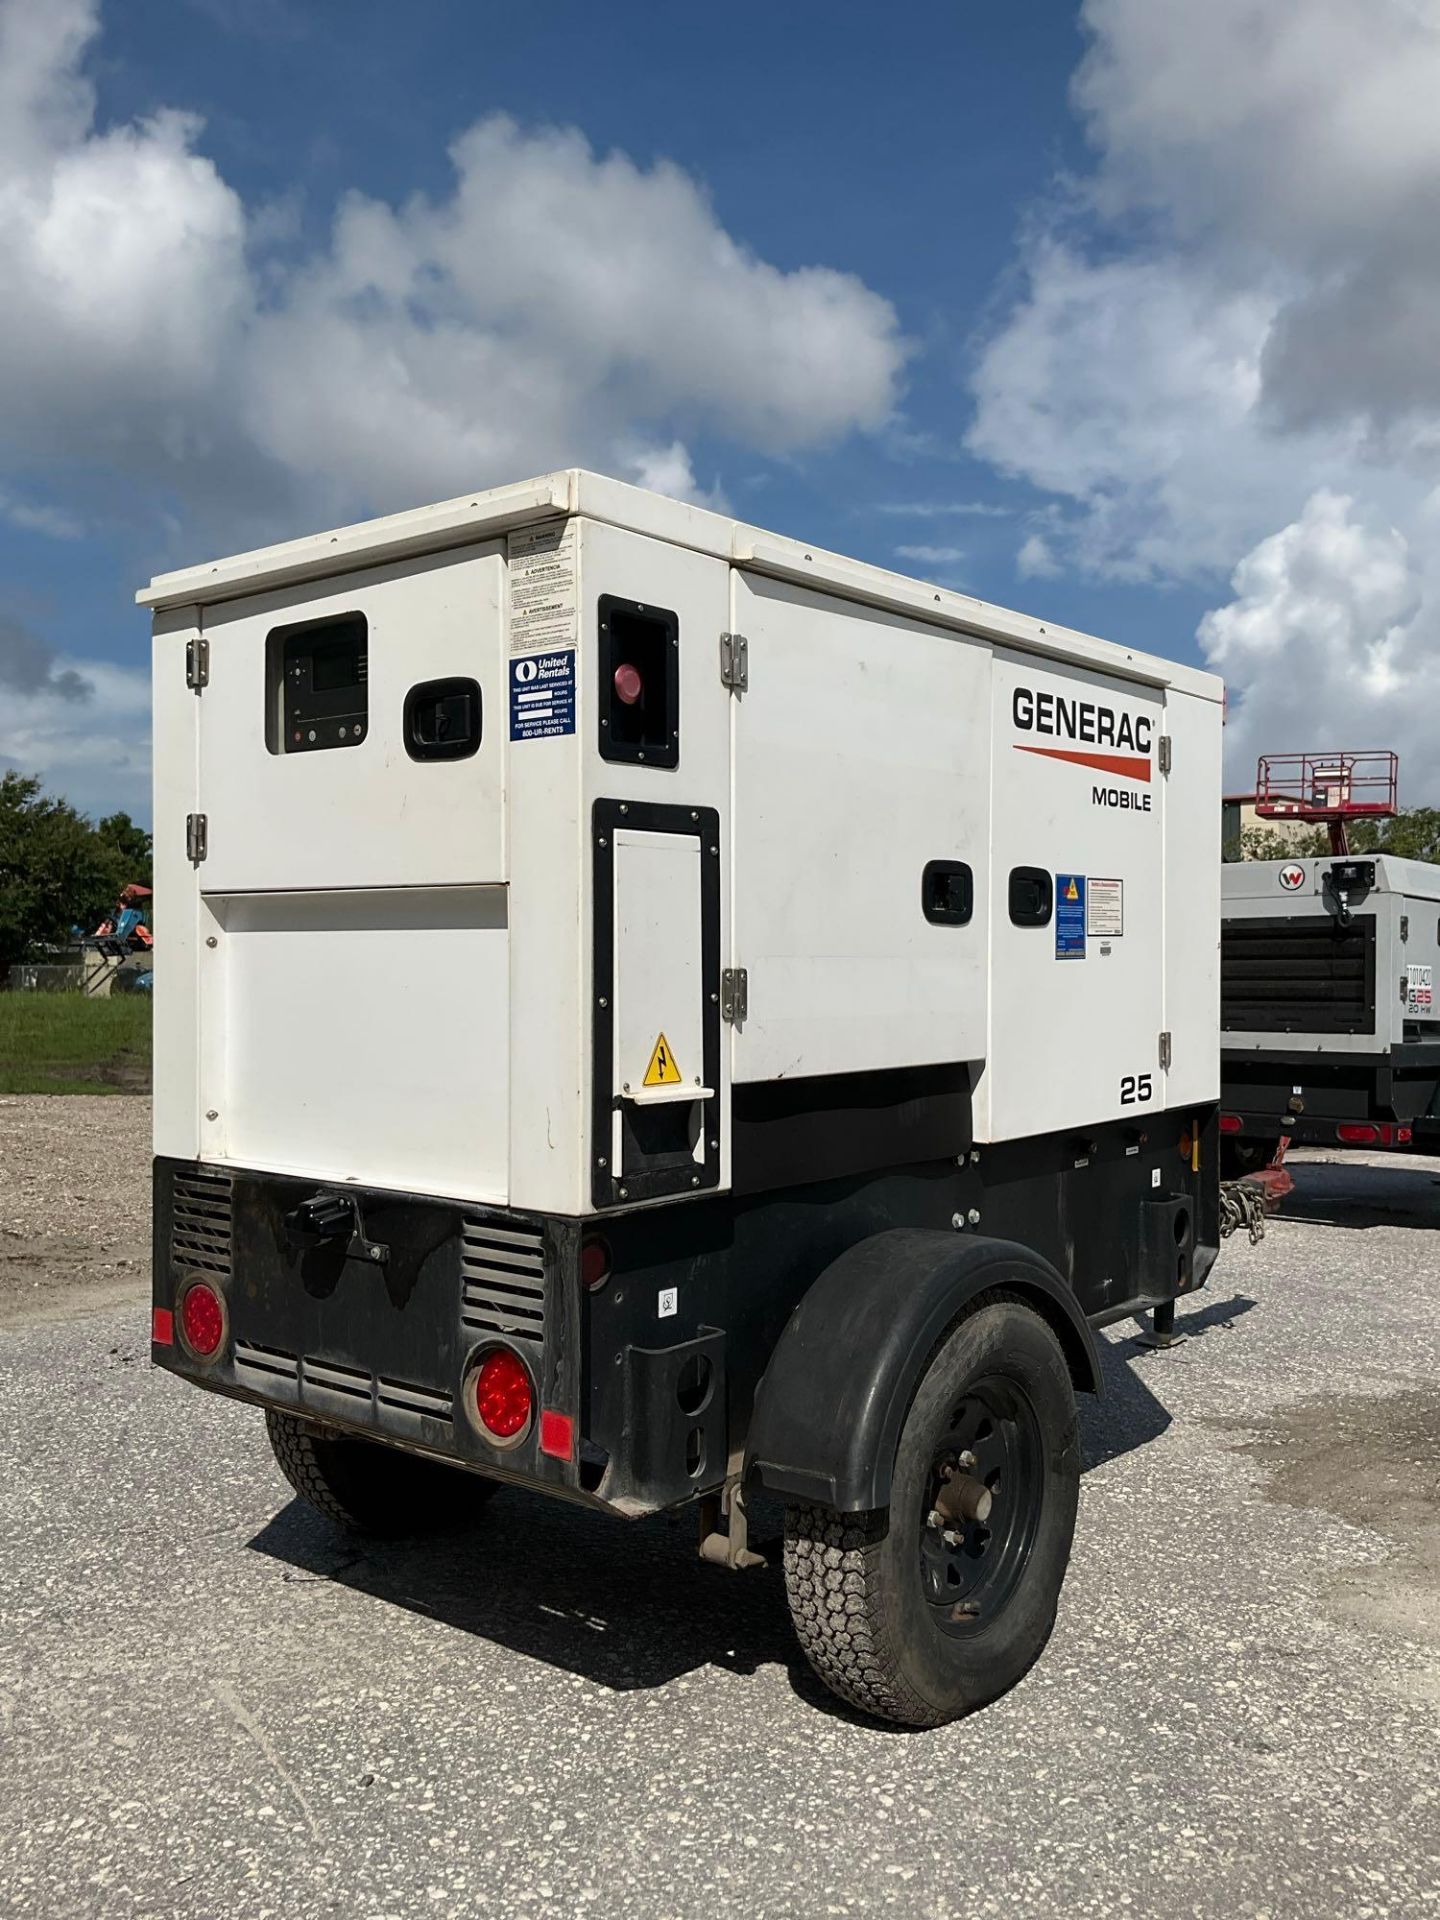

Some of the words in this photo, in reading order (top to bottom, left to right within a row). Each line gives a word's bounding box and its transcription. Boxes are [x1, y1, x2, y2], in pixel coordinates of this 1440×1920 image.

[530, 564, 561, 575] ADVERTENCIA
[528, 602, 563, 614] AVERTISSEMENT
[538, 655, 568, 669] United
[538, 666, 570, 680] Rentals
[549, 680, 568, 688] SERVICED
[524, 720, 542, 728] SERVICE
[543, 718, 559, 726] PLEASE
[1012, 687, 1152, 754] GENERAC
[522, 726, 564, 737] 800-UR-RENTS
[1092, 786, 1152, 812] MOBILE
[1408, 989, 1432, 1004] G25
[1408, 1004, 1419, 1014] 20
[1120, 1073, 1152, 1105] 25
